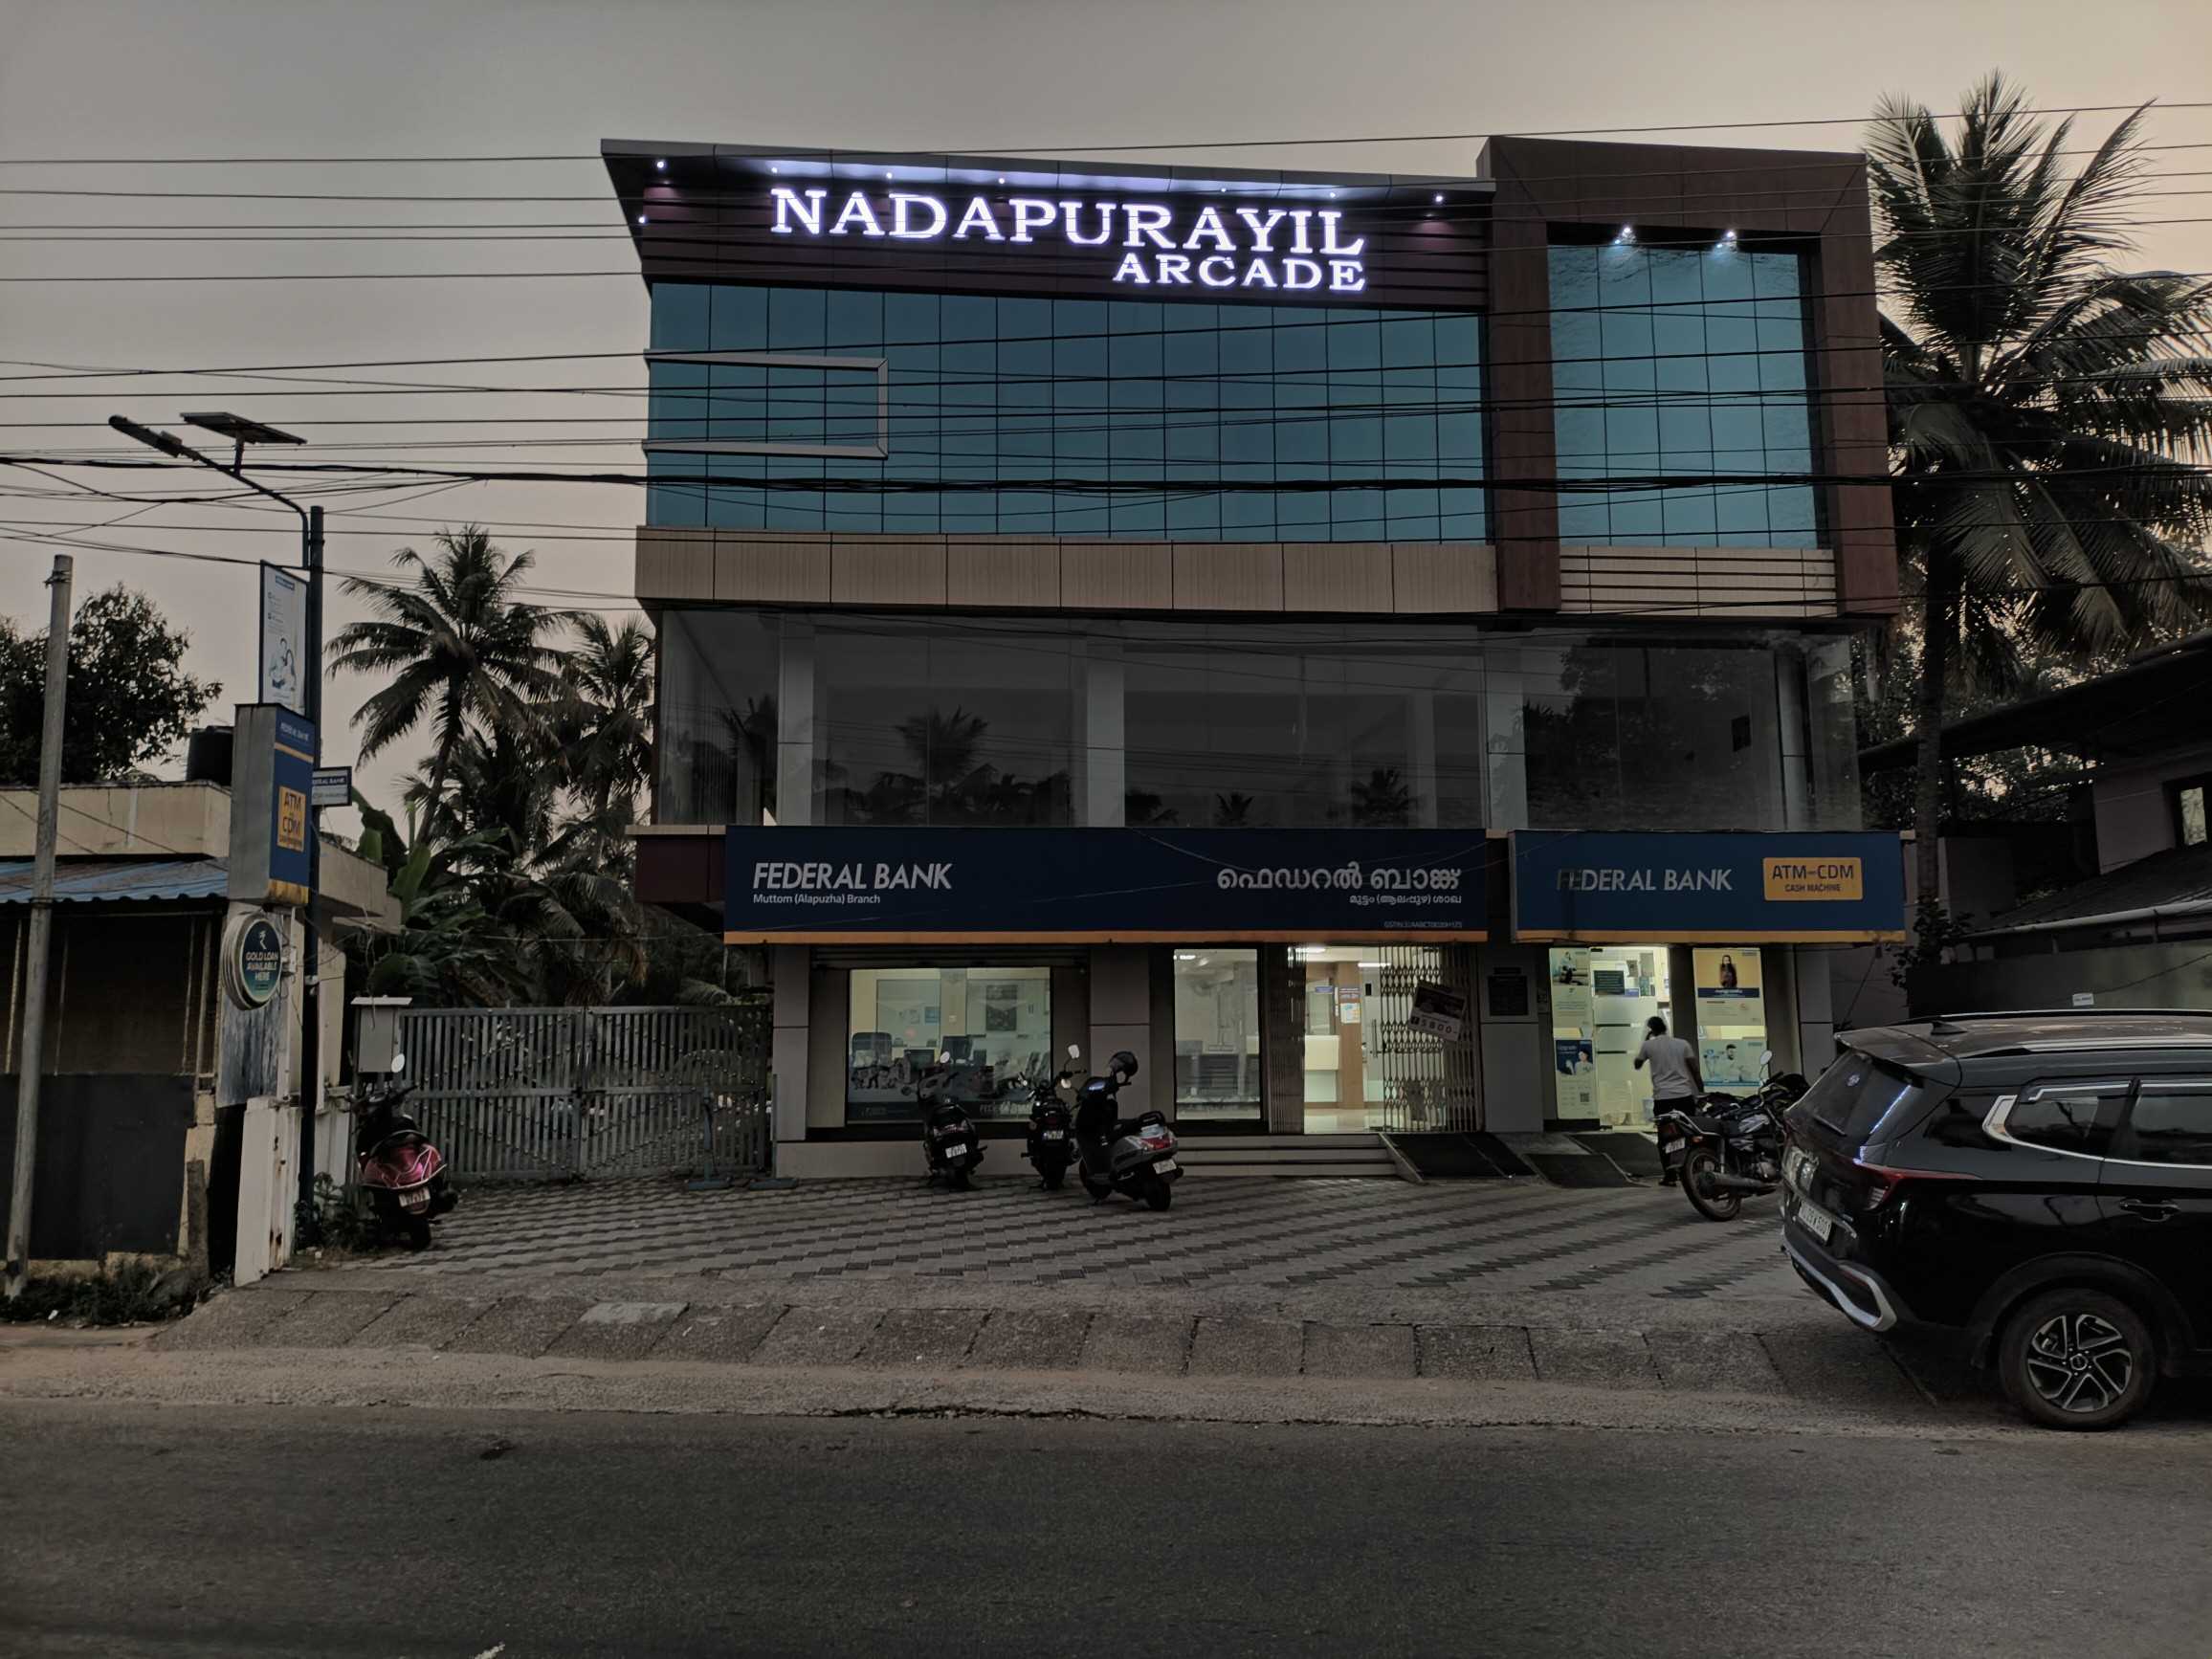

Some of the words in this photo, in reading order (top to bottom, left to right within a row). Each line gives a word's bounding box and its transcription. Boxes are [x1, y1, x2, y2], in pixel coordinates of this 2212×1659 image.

[770, 188, 1365, 255] NADAPURAYIL
[1113, 253, 1367, 292] ARCADE
[753, 862, 867, 890] FEDERAL
[874, 862, 953, 890] BANK
[1663, 868, 1733, 892] BANK
[1784, 883, 1805, 894] CASH
[1806, 883, 1841, 894] MACHINE
[753, 893, 793, 904] Muttom
[794, 893, 845, 906] (Alapuzha)
[847, 893, 881, 904] Branch
